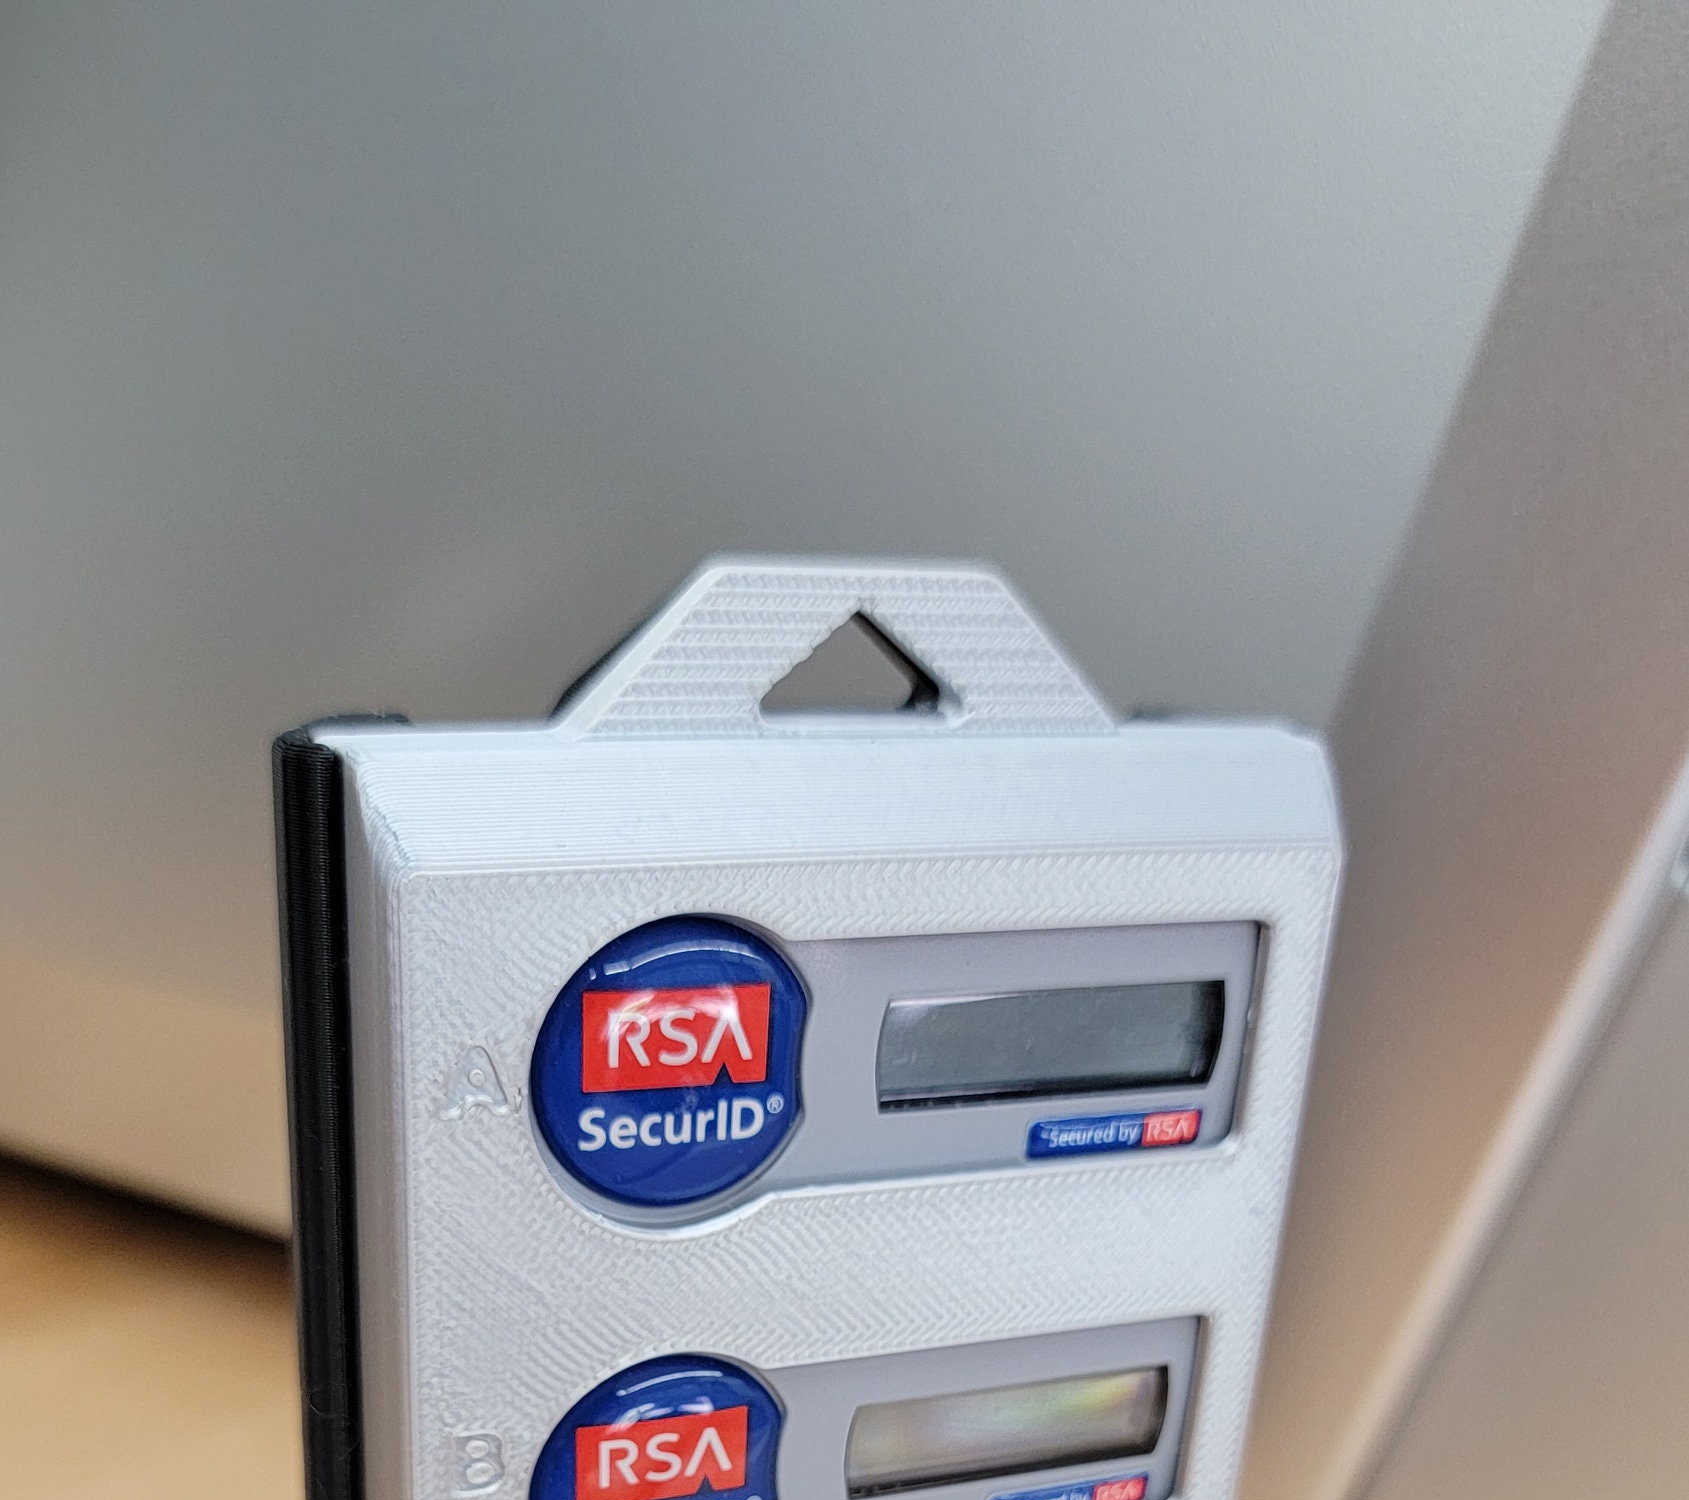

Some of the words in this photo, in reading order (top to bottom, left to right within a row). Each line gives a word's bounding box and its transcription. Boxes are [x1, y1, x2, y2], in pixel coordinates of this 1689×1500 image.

[608, 1004, 752, 1069] RSA
[440, 1044, 511, 1120] A
[1048, 1123, 1114, 1148] Secured
[1118, 1121, 1138, 1146] by
[1145, 1115, 1191, 1142] RSA
[453, 1433, 504, 1495] B
[599, 1427, 732, 1489] RSA
